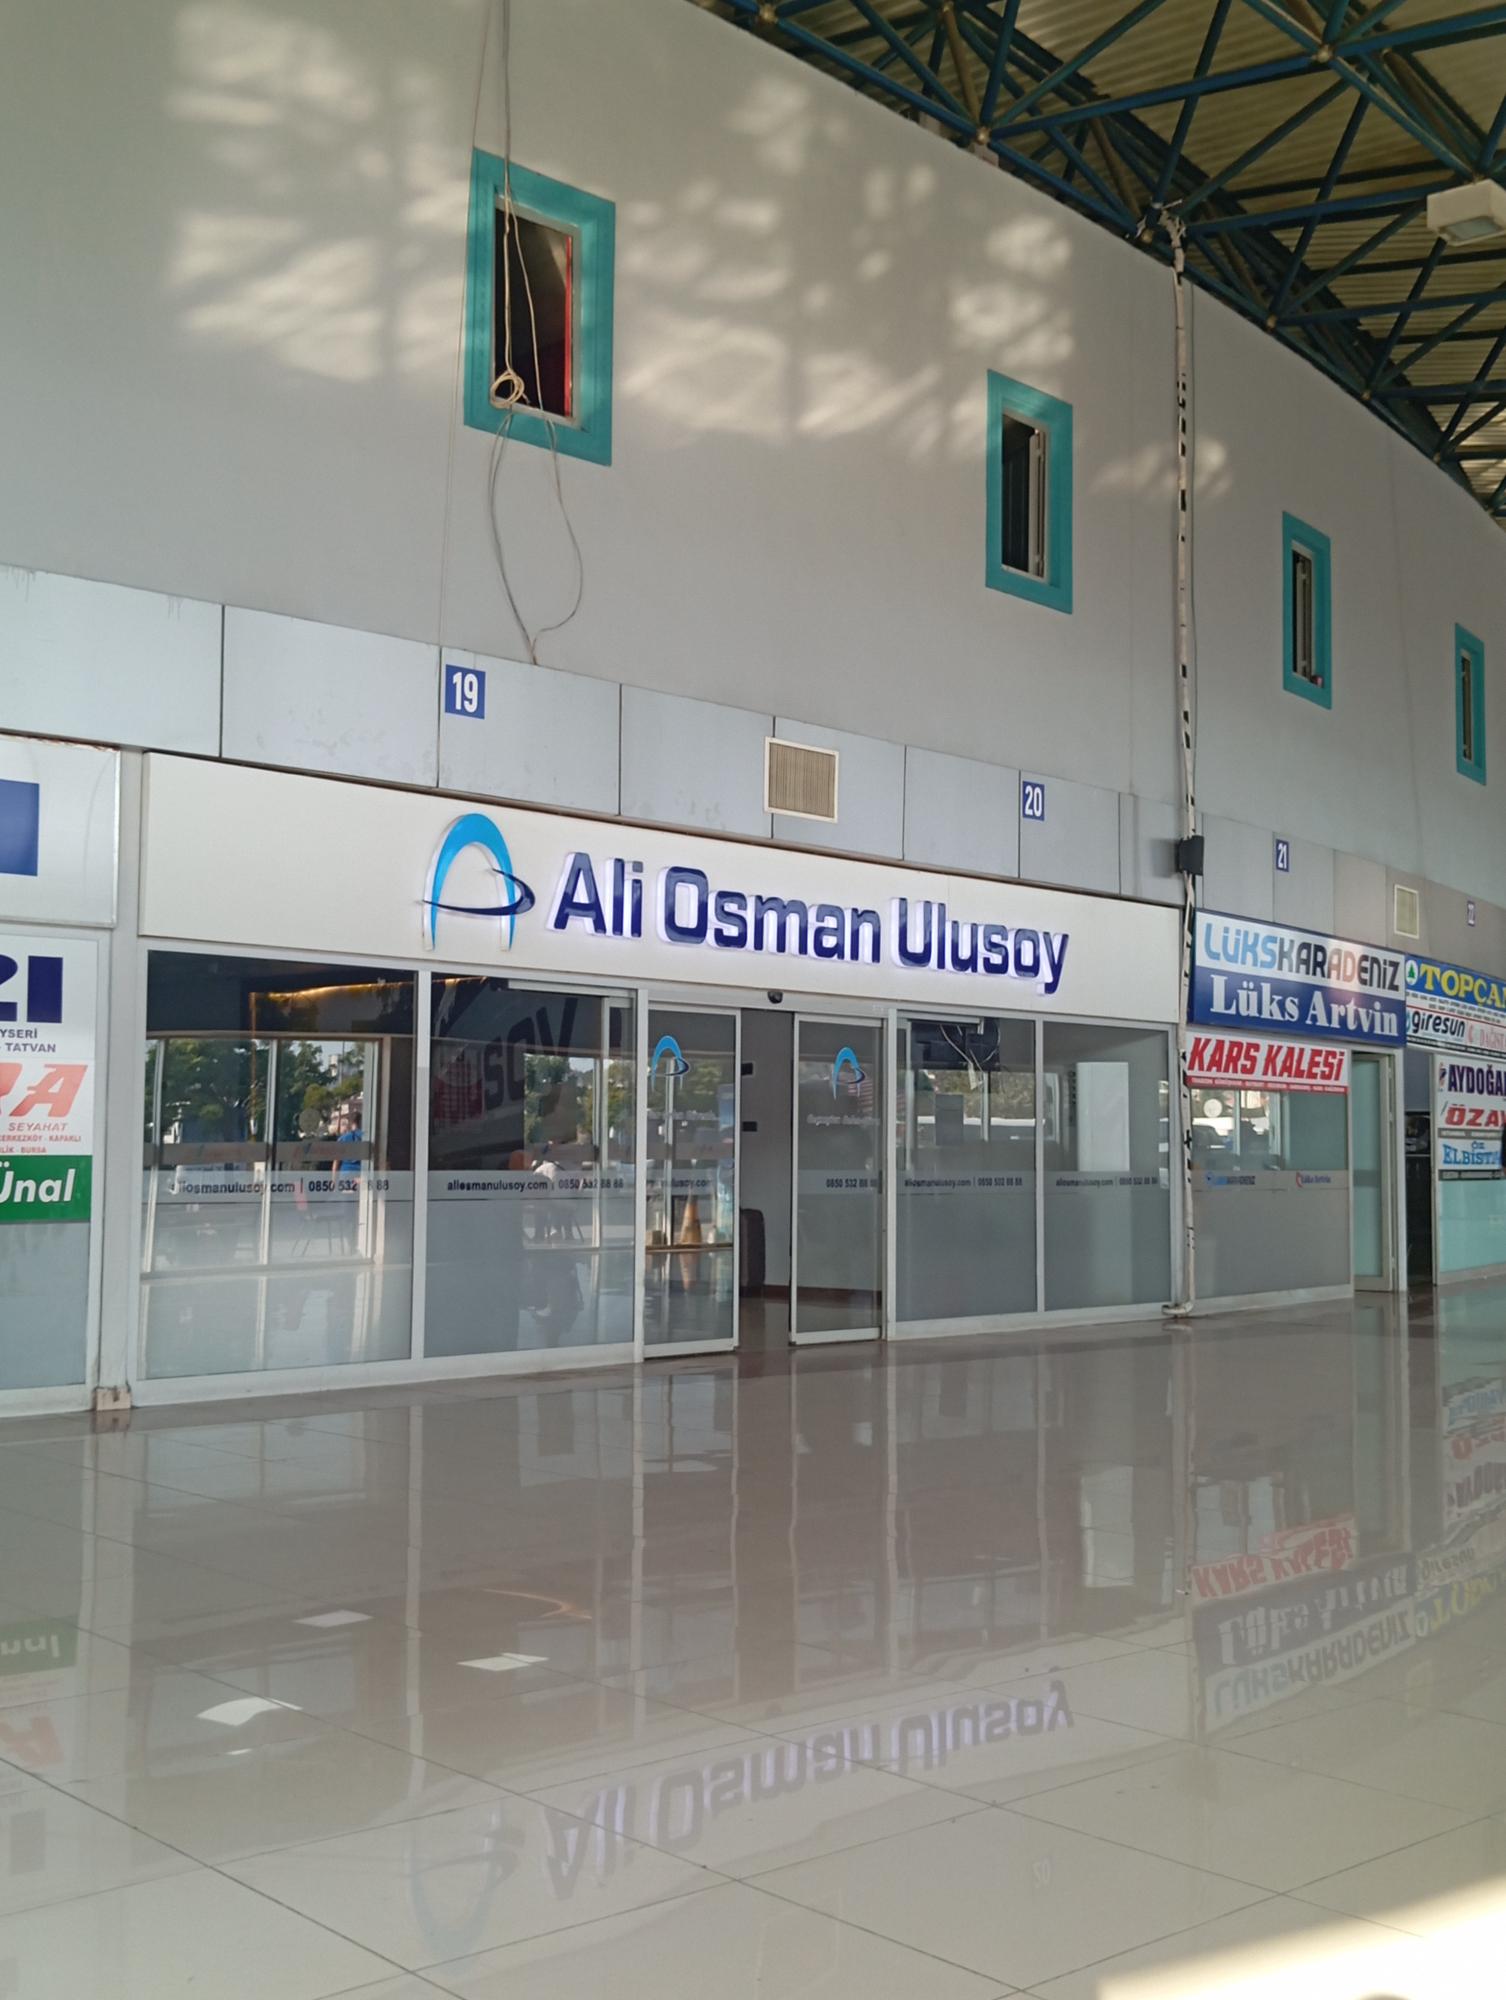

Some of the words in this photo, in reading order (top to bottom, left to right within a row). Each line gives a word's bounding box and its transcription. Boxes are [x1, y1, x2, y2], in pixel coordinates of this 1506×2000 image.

[453, 672, 478, 713] 19
[1025, 785, 1042, 817] 20
[1278, 843, 1287, 869] 21
[550, 852, 643, 939] Ali
[660, 866, 880, 964] Osman
[895, 897, 1070, 995] Ulusoy
[1210, 974, 1300, 1022] Lüks
[1305, 990, 1399, 1037] Artvin
[1411, 1010, 1466, 1038] giresun
[5, 1042, 56, 1053] TATVAN
[1187, 1037, 1260, 1076] KARS
[1262, 1044, 1345, 1081] KALESİ
[9, 1122, 68, 1132] SEYAHAT
[308, 1180, 335, 1192] 0850
